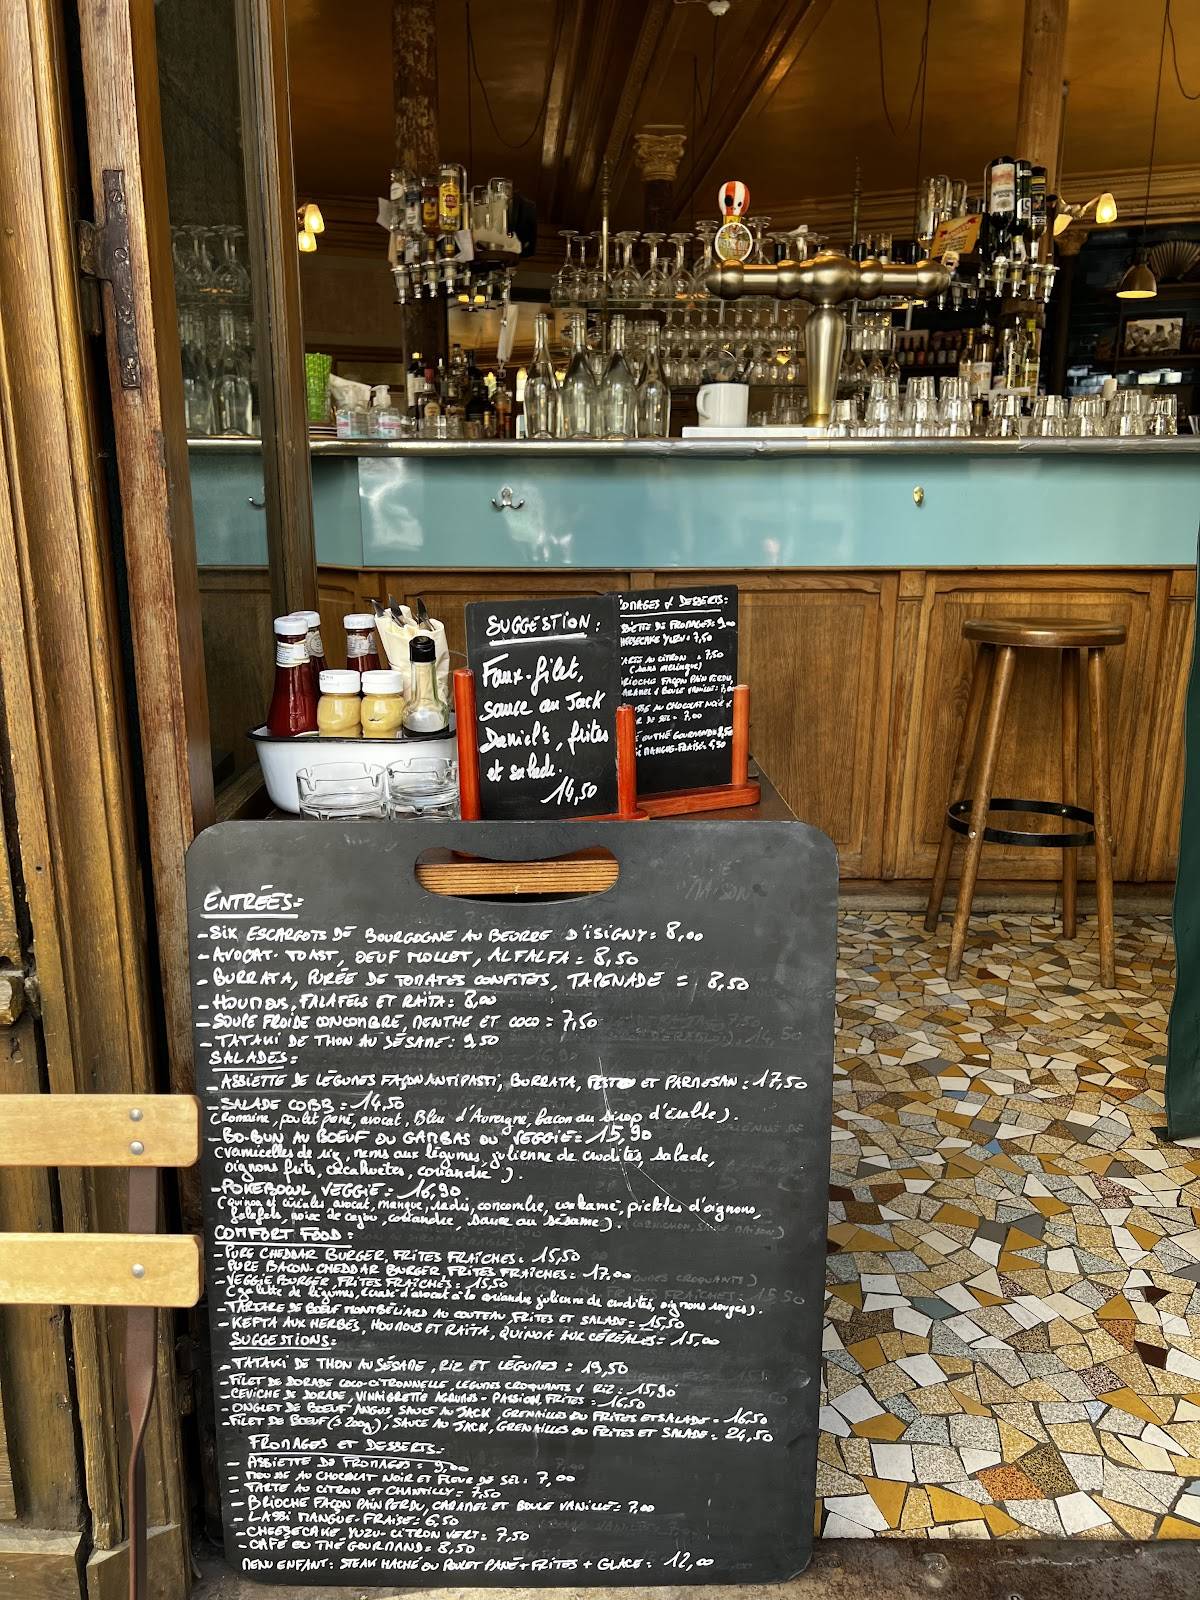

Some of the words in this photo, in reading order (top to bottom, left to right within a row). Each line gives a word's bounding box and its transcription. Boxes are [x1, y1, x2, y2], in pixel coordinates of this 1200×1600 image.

[693, 632, 712, 644] 7,50
[705, 649, 724, 659] 7,50
[479, 701, 533, 721] sauce
[539, 699, 559, 713] au
[565, 690, 605, 711] Jack
[568, 719, 608, 755] frites
[487, 759, 504, 781] et
[538, 775, 597, 805] 14,50
[247, 926, 327, 942] ESCARGOTS
[365, 928, 457, 944] BOURGOGNE
[461, 929, 482, 942] AU
[489, 929, 553, 942] BEURRE
[667, 921, 703, 942] 8,00
[594, 946, 638, 967] 8,50
[213, 967, 298, 990] BURRATA,
[308, 968, 358, 985] PURÉE
[366, 972, 388, 986] DE
[395, 974, 465, 987] TOMATES
[567, 972, 665, 989] TAPENADE
[708, 971, 749, 991] 8,50
[299, 993, 368, 1009] FALAFELS
[376, 994, 397, 1008] ET
[465, 989, 496, 1009] 8,00
[213, 1014, 258, 1029] SOUPE
[413, 1015, 472, 1030] MENTHE
[480, 1016, 501, 1028] ET
[509, 1016, 539, 1027] COCO
[563, 1010, 597, 1031] 7,50
[288, 1035, 309, 1047] DE
[314, 1035, 352, 1046] THON
[358, 1035, 377, 1047] AU
[464, 1034, 499, 1048] 9,50
[291, 1073, 309, 1088] DE
[316, 1070, 376, 1087] LÉGUMES
[381, 1074, 428, 1090] FAÇON
[641, 1078, 660, 1088] ET
[665, 1075, 737, 1090] PARMESAN
[753, 1070, 807, 1090] 17,50
[221, 1097, 281, 1110] SALADE
[288, 1098, 334, 1113] COBB
[350, 1091, 404, 1111] 14,50
[279, 1111, 319, 1130] poulet
[360, 1113, 409, 1127] avocat,
[414, 1109, 445, 1125] Bleu
[535, 1108, 572, 1125] bacon
[223, 1129, 284, 1146] BO-BUN
[293, 1131, 309, 1144] AU
[375, 1133, 396, 1145] OU
[403, 1130, 470, 1146] GAMBAS
[480, 1135, 498, 1145] OU
[585, 1124, 652, 1145] 15,90
[394, 1151, 418, 1159] aux
[557, 1147, 577, 1161] de
[650, 1143, 714, 1167] salade,
[223, 1160, 278, 1182] oignons
[397, 1181, 461, 1201] 16,90
[215, 1225, 294, 1241] COMFORT
[225, 1244, 256, 1261] PURE
[260, 1247, 318, 1259] CHEDDAR
[532, 1247, 580, 1265] 15,50
[228, 1259, 258, 1274] PURE
[266, 1259, 379, 1274] BACON-CHEDDAR
[465, 1274, 508, 1291] 15,50
[232, 1316, 277, 1329] KEFTA
[283, 1316, 306, 1328] AUX
[425, 1324, 442, 1334] ET
[670, 1331, 720, 1347] 15,00
[639, 1316, 684, 1331] 15,50
[295, 1358, 310, 1370] DE
[316, 1358, 352, 1370] THON
[469, 1360, 490, 1371] ET
[581, 1361, 628, 1377] 19,50
[286, 1376, 334, 1388] DORADE
[625, 1383, 678, 1400] 15,90
[597, 1395, 645, 1409] 16,50
[232, 1403, 282, 1413] ONGLET
[285, 1402, 301, 1413] DE
[456, 1406, 491, 1418] JACK
[724, 1408, 767, 1424] 16,50
[268, 1416, 284, 1425] DE
[725, 1427, 773, 1442] 24,50
[248, 1434, 328, 1450] FROMAGES
[337, 1440, 358, 1449] ET
[296, 1471, 312, 1481] AU
[316, 1471, 378, 1481] CHOCOLAT
[417, 1475, 432, 1483] ET
[537, 1471, 575, 1487] 7,00
[244, 1482, 290, 1492] TARTE
[294, 1484, 310, 1492] AU
[472, 1486, 501, 1499] 7,50
[432, 1500, 487, 1512] CARAMEL
[517, 1500, 554, 1511] BOULE
[628, 1501, 654, 1514] 7,00
[425, 1514, 459, 1527] 6,50
[247, 1526, 340, 1539] CHEESECAKE
[497, 1527, 529, 1542] 7,50
[248, 1534, 290, 1550] CAFÉ
[292, 1541, 311, 1549] OU
[438, 1541, 475, 1554] 8,50
[242, 1558, 273, 1570] MENU
[340, 1558, 377, 1569] STEAK
[421, 1562, 439, 1571] OU
[664, 1551, 714, 1571] 12,00
